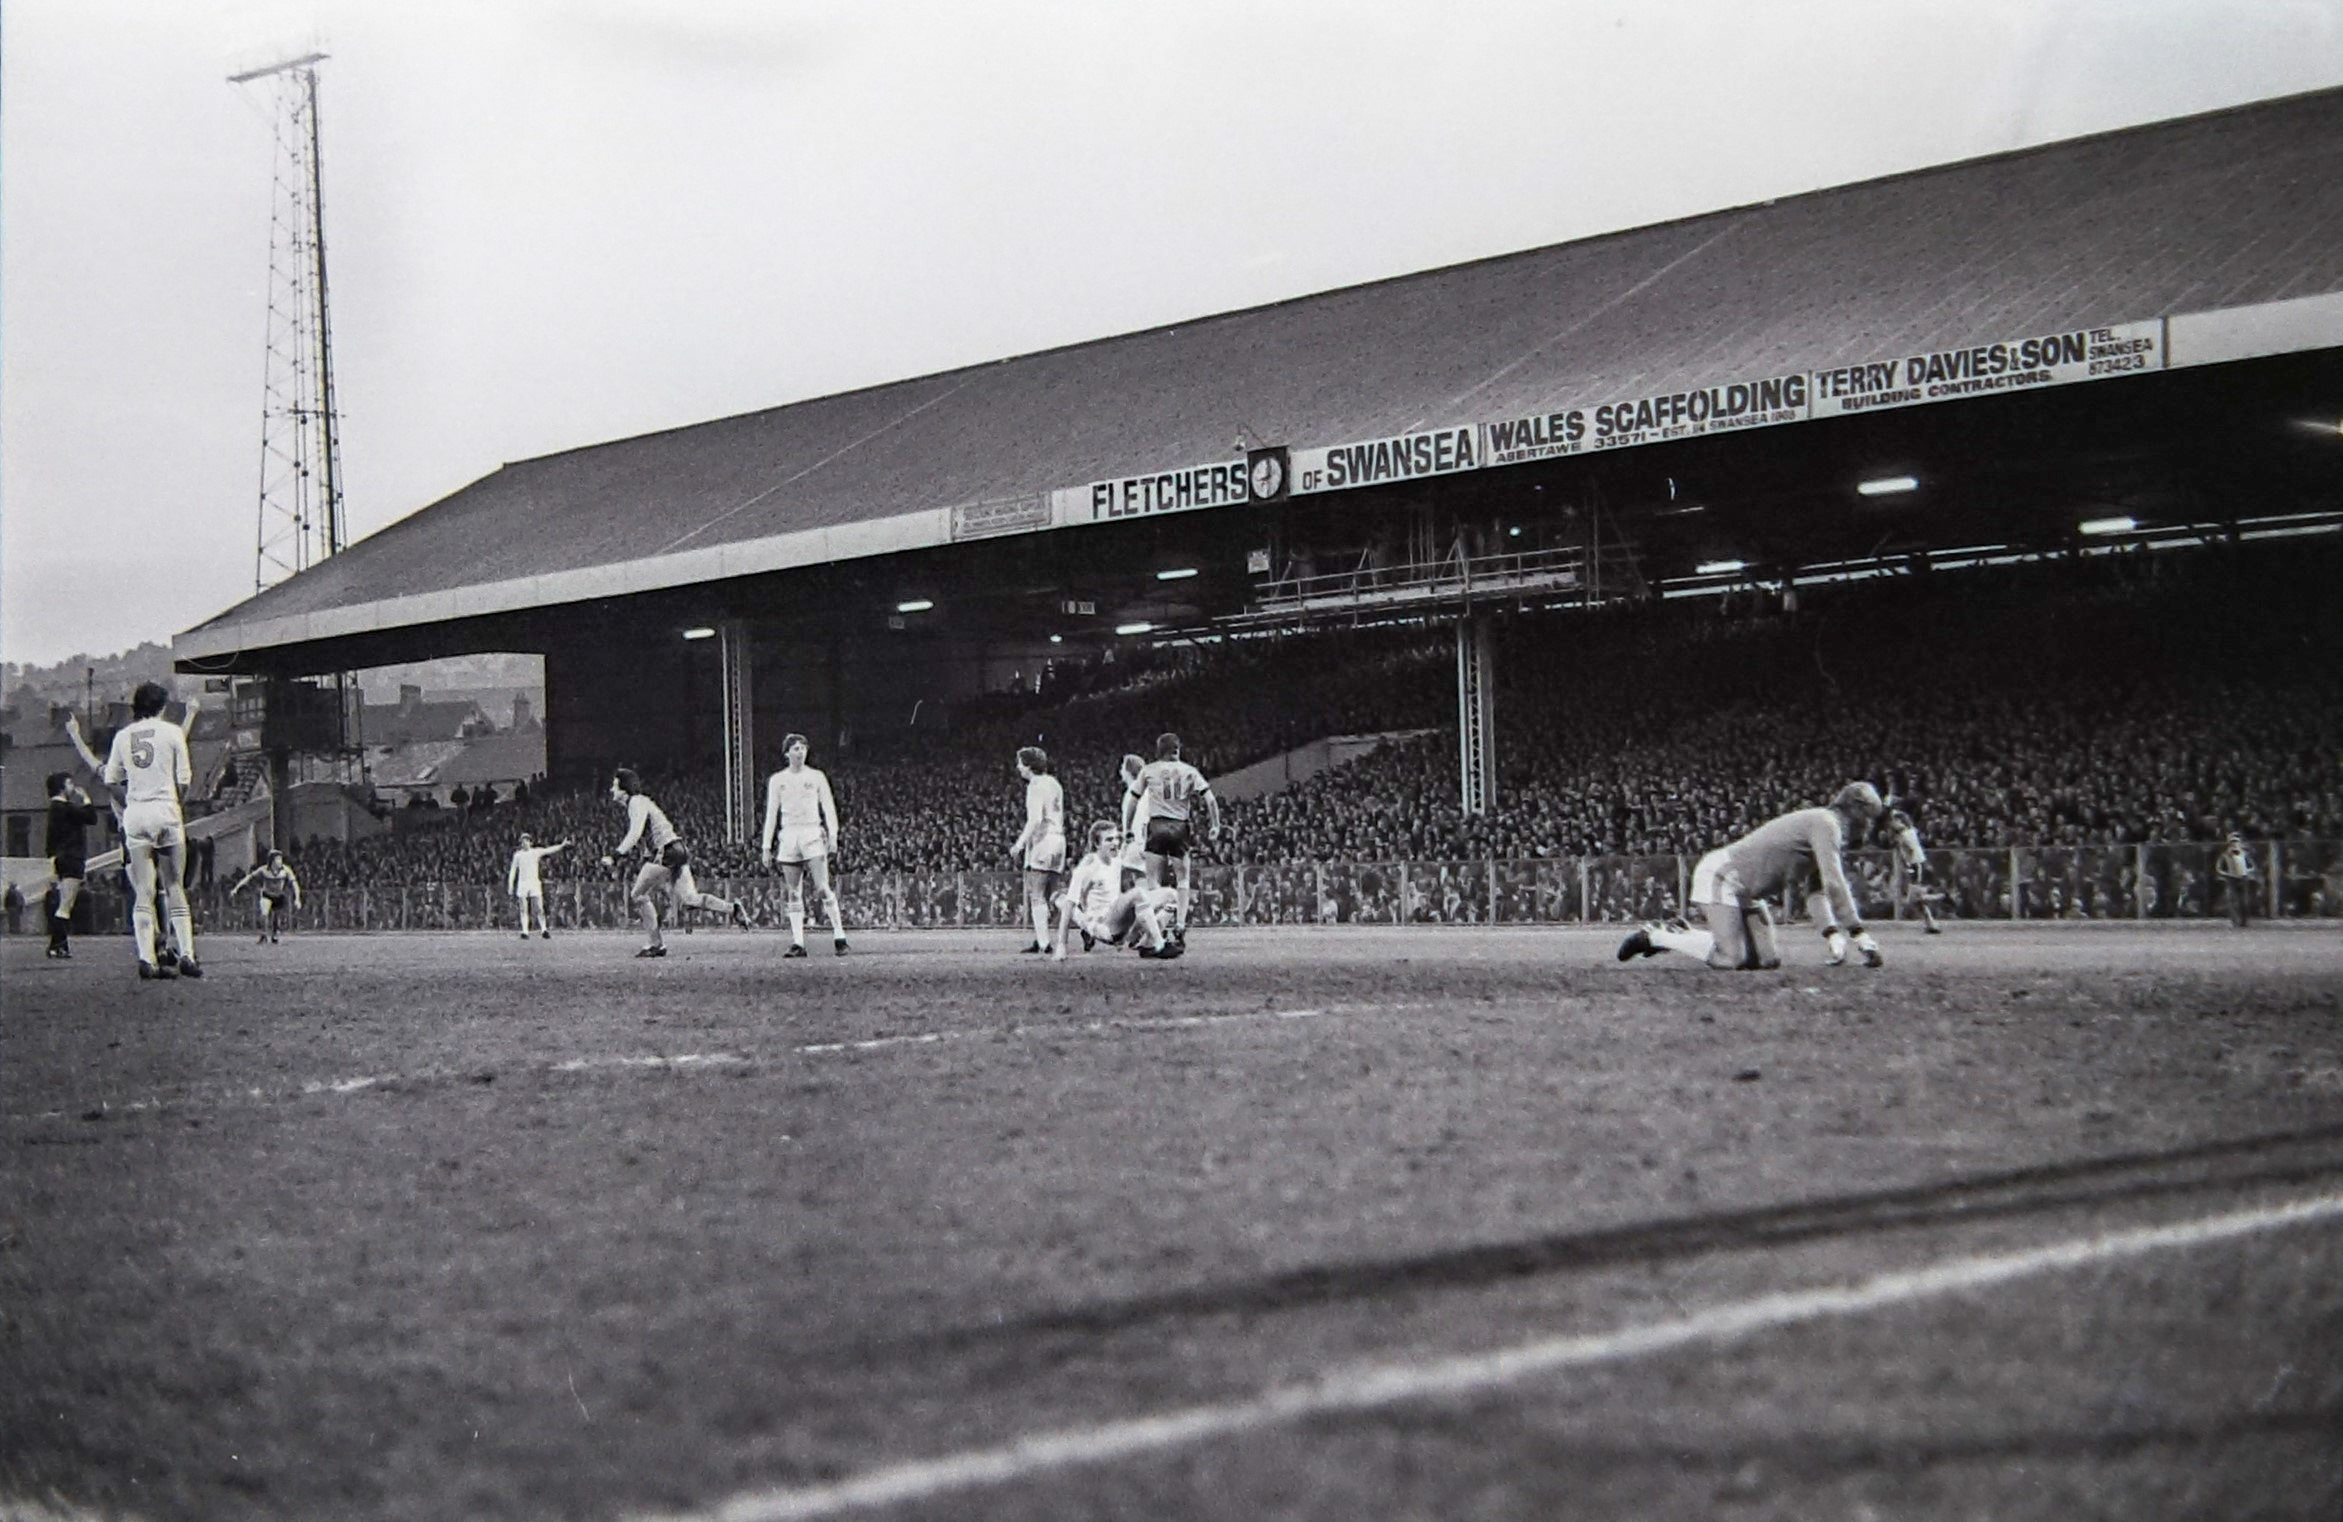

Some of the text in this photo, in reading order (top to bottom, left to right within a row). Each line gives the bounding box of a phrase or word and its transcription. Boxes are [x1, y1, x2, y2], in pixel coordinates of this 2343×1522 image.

[2089, 338, 2153, 360] SWANSEA
[1815, 360, 1899, 400] TERRY
[1841, 387, 1922, 411] BUILDING
[1490, 375, 1806, 453] WALES SCAFFOLDING
[1303, 428, 1474, 491] OF SWANSEA
[1495, 442, 1582, 464] ABERTAWE
[1709, 412, 1769, 431] SWANSEA
[1092, 463, 1248, 520] FLETCHERS
[131, 729, 155, 768] 5
